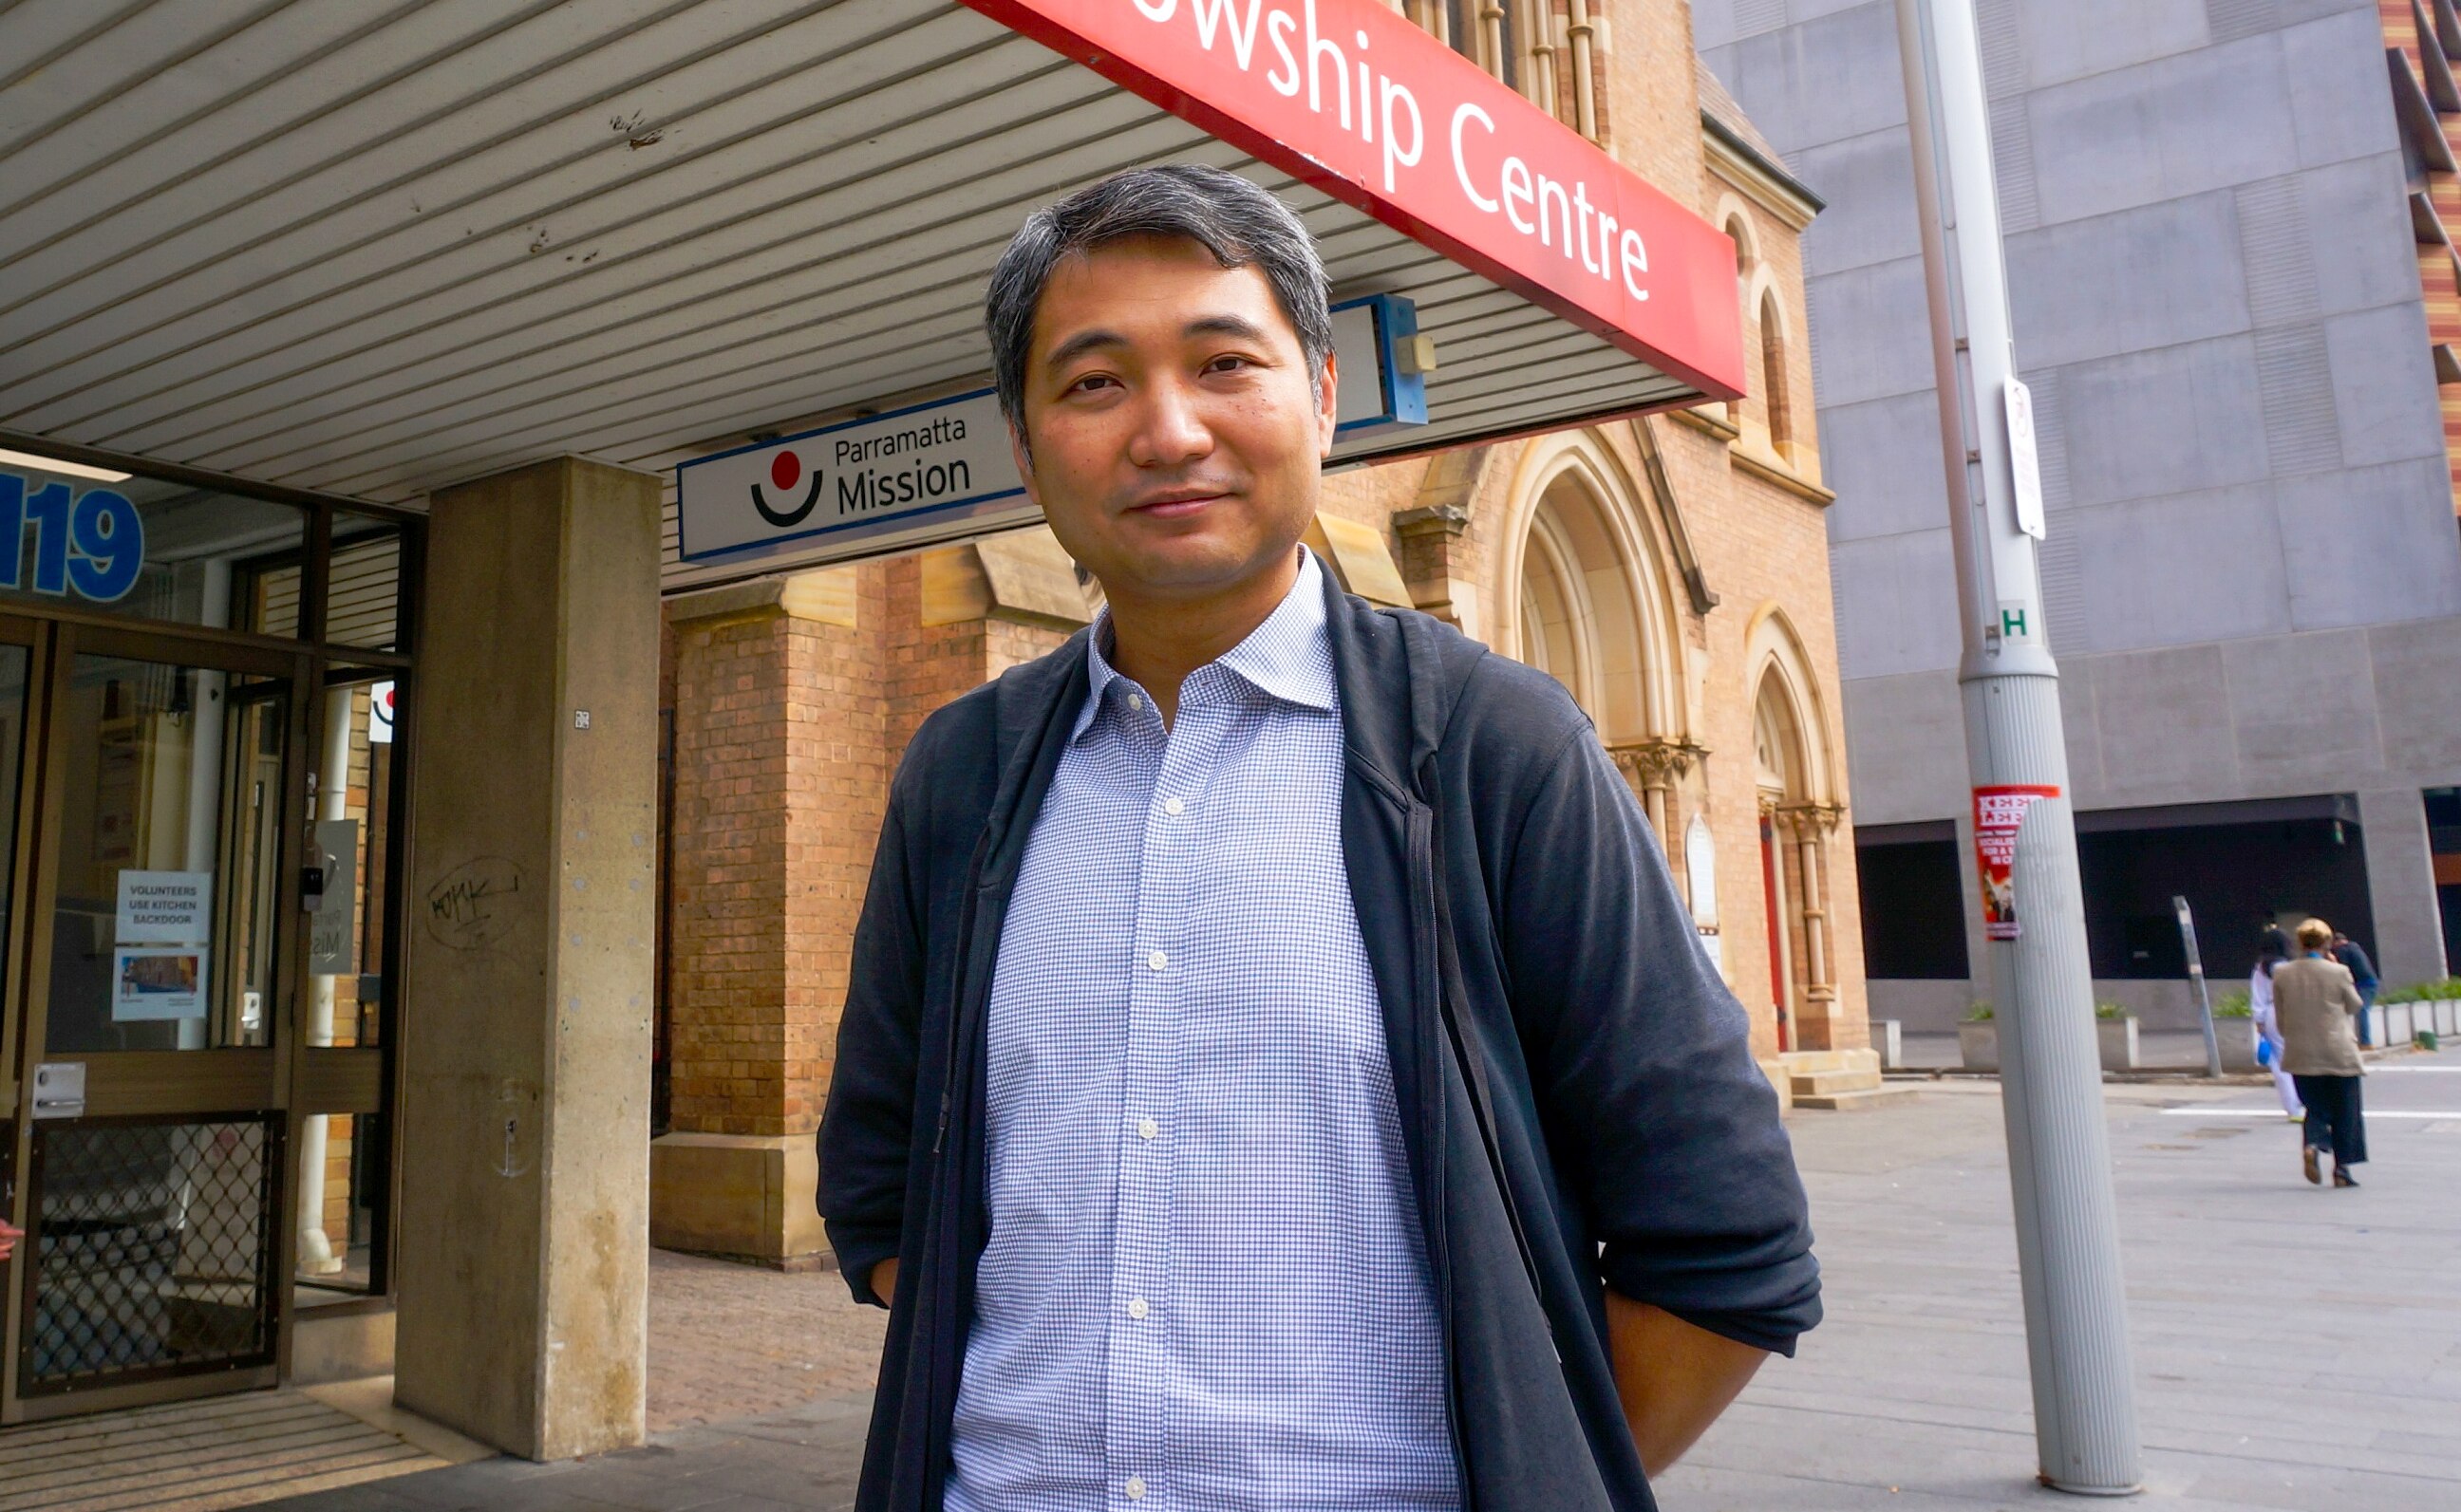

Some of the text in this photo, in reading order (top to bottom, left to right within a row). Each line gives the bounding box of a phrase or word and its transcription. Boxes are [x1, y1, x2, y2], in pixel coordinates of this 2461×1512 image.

[1138, 0, 1649, 301] wship Centre
[836, 416, 967, 466] Parramatta
[837, 458, 970, 514] Mission
[0, 473, 144, 602] 119
[2002, 608, 2027, 637] H
[129, 901, 197, 910] USE KITCHEN
[130, 886, 197, 896] VOLUNTEERS
[133, 914, 192, 924] BACKDOOR
